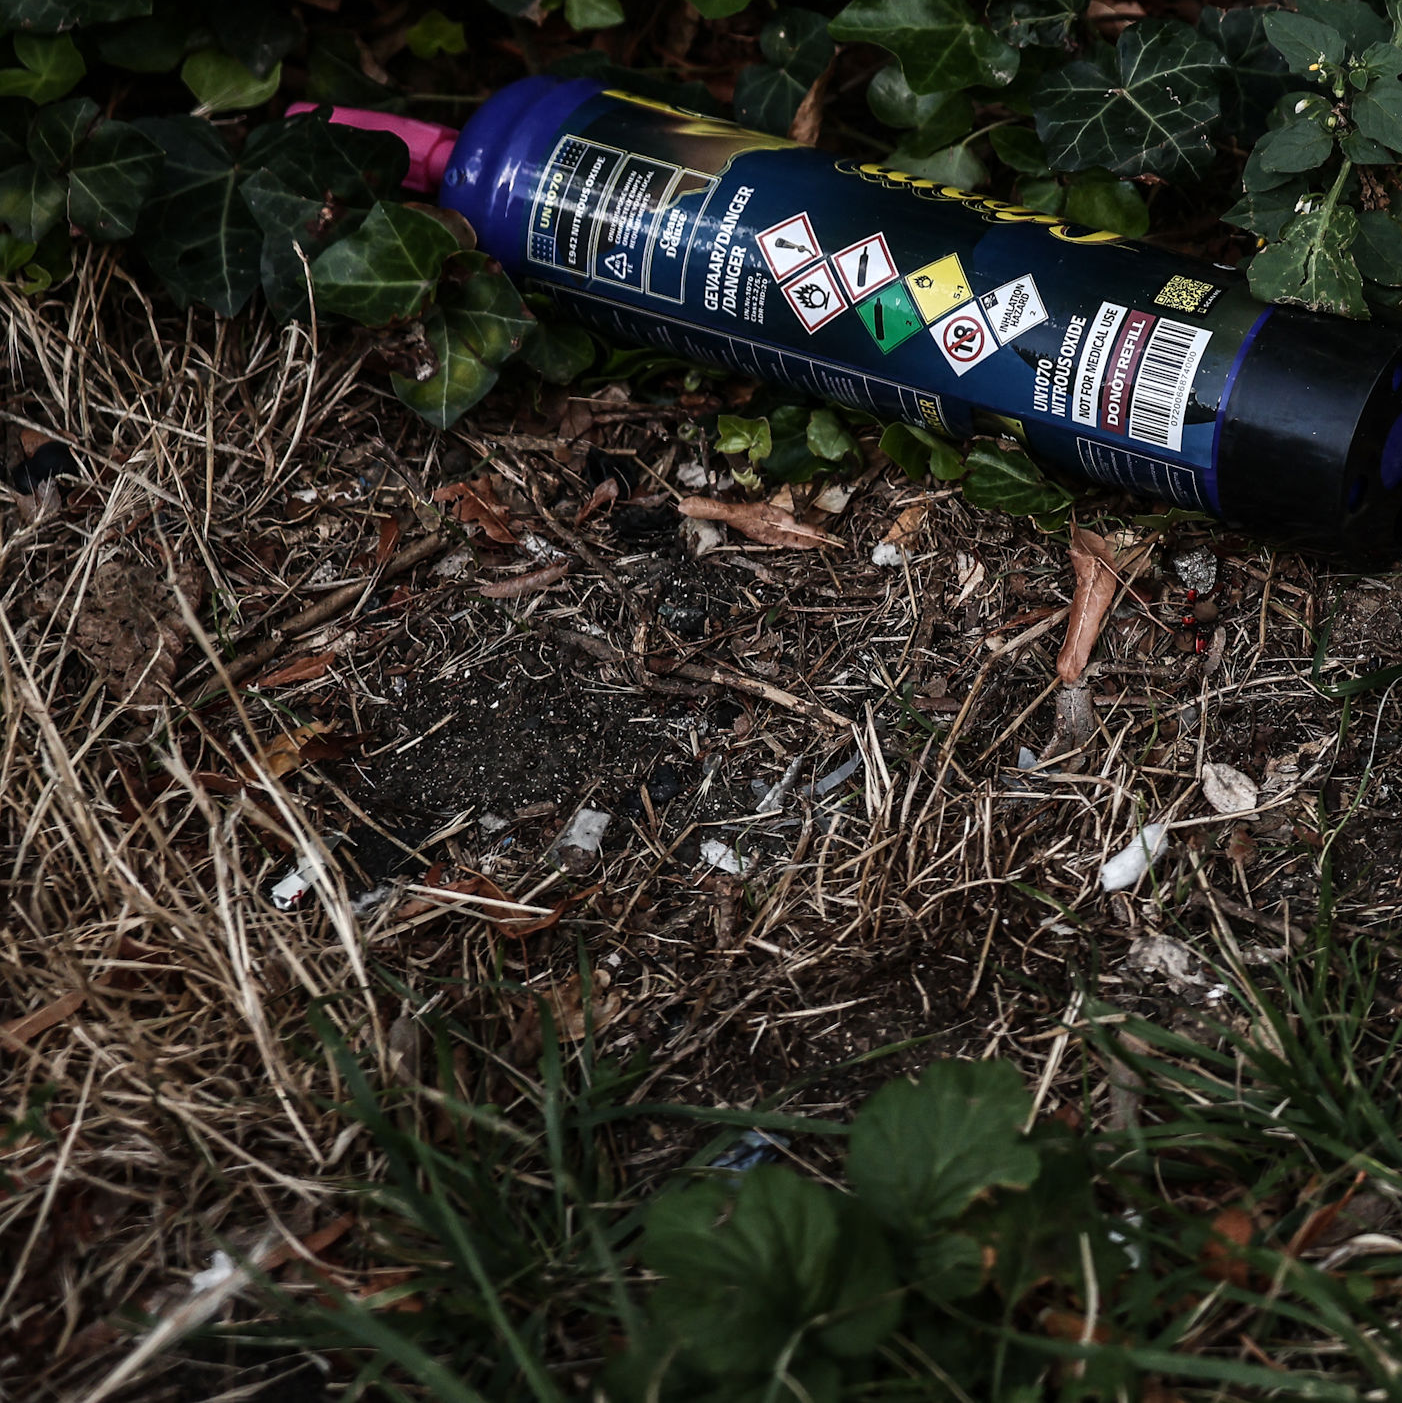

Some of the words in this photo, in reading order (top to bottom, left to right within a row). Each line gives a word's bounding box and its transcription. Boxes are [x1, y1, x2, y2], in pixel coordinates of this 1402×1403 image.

[538, 170, 565, 229] UN1070
[569, 185, 592, 237] NITROUS
[584, 153, 607, 188] OXIDE
[998, 282, 1024, 333] INHALATION
[1010, 291, 1030, 327] HAZARD
[1100, 306, 1118, 328] USE
[1060, 313, 1087, 357] OXIDE
[1085, 327, 1109, 374] MEDICAL
[1115, 316, 1147, 373] REFILL
[1032, 357, 1053, 413] UN1070
[1050, 355, 1073, 418] NITROUS
[1077, 396, 1092, 420] NOT
[1080, 373, 1095, 397] FOR
